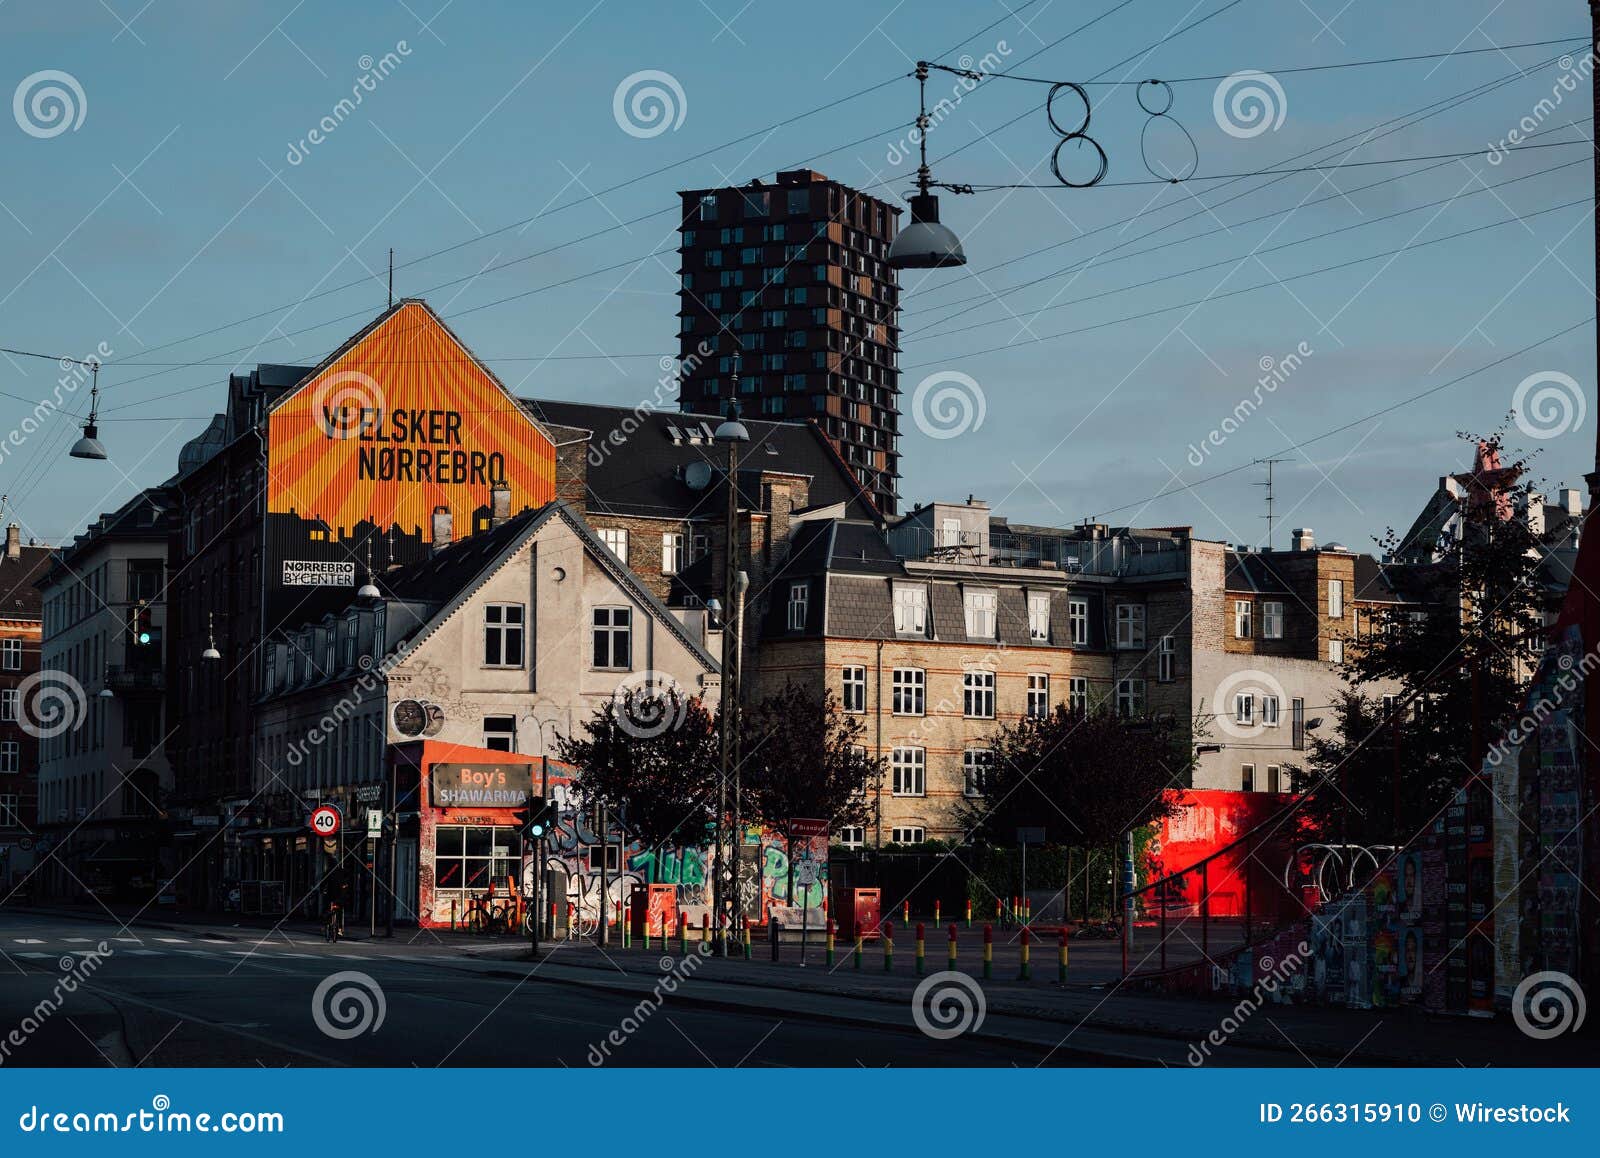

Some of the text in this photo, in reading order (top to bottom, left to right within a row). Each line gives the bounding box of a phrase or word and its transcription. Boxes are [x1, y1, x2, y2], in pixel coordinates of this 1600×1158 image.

[359, 407, 462, 445] ELSKER
[358, 446, 505, 485] NØRREBRO
[284, 562, 353, 573] NØRREBRO
[283, 572, 353, 586] BYCENTER
[461, 768, 506, 788] Boy's
[440, 789, 527, 803] SHAWARMA
[315, 815, 334, 827] 40
